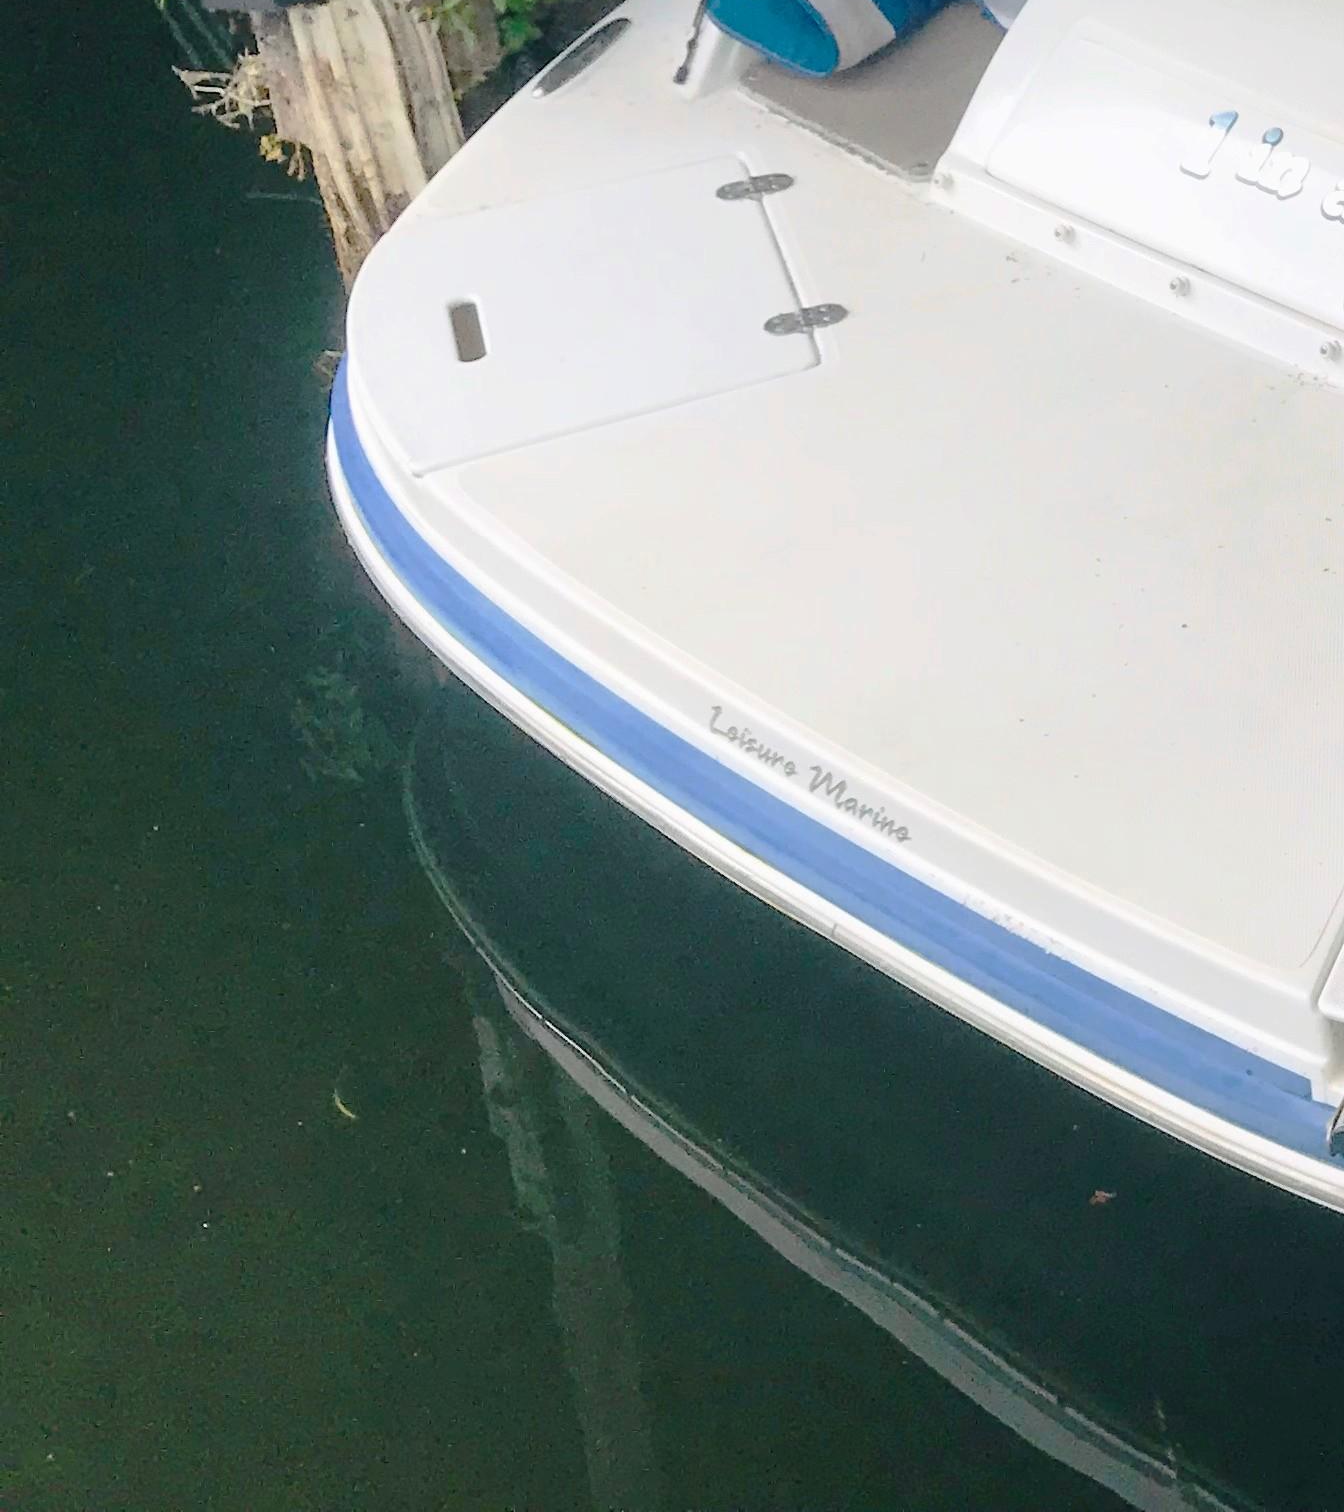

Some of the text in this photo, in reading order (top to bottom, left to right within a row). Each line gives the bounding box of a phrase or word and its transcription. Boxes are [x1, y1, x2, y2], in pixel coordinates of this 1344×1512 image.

[1235, 126, 1311, 200] in
[708, 705, 912, 843] Leisure Marine
